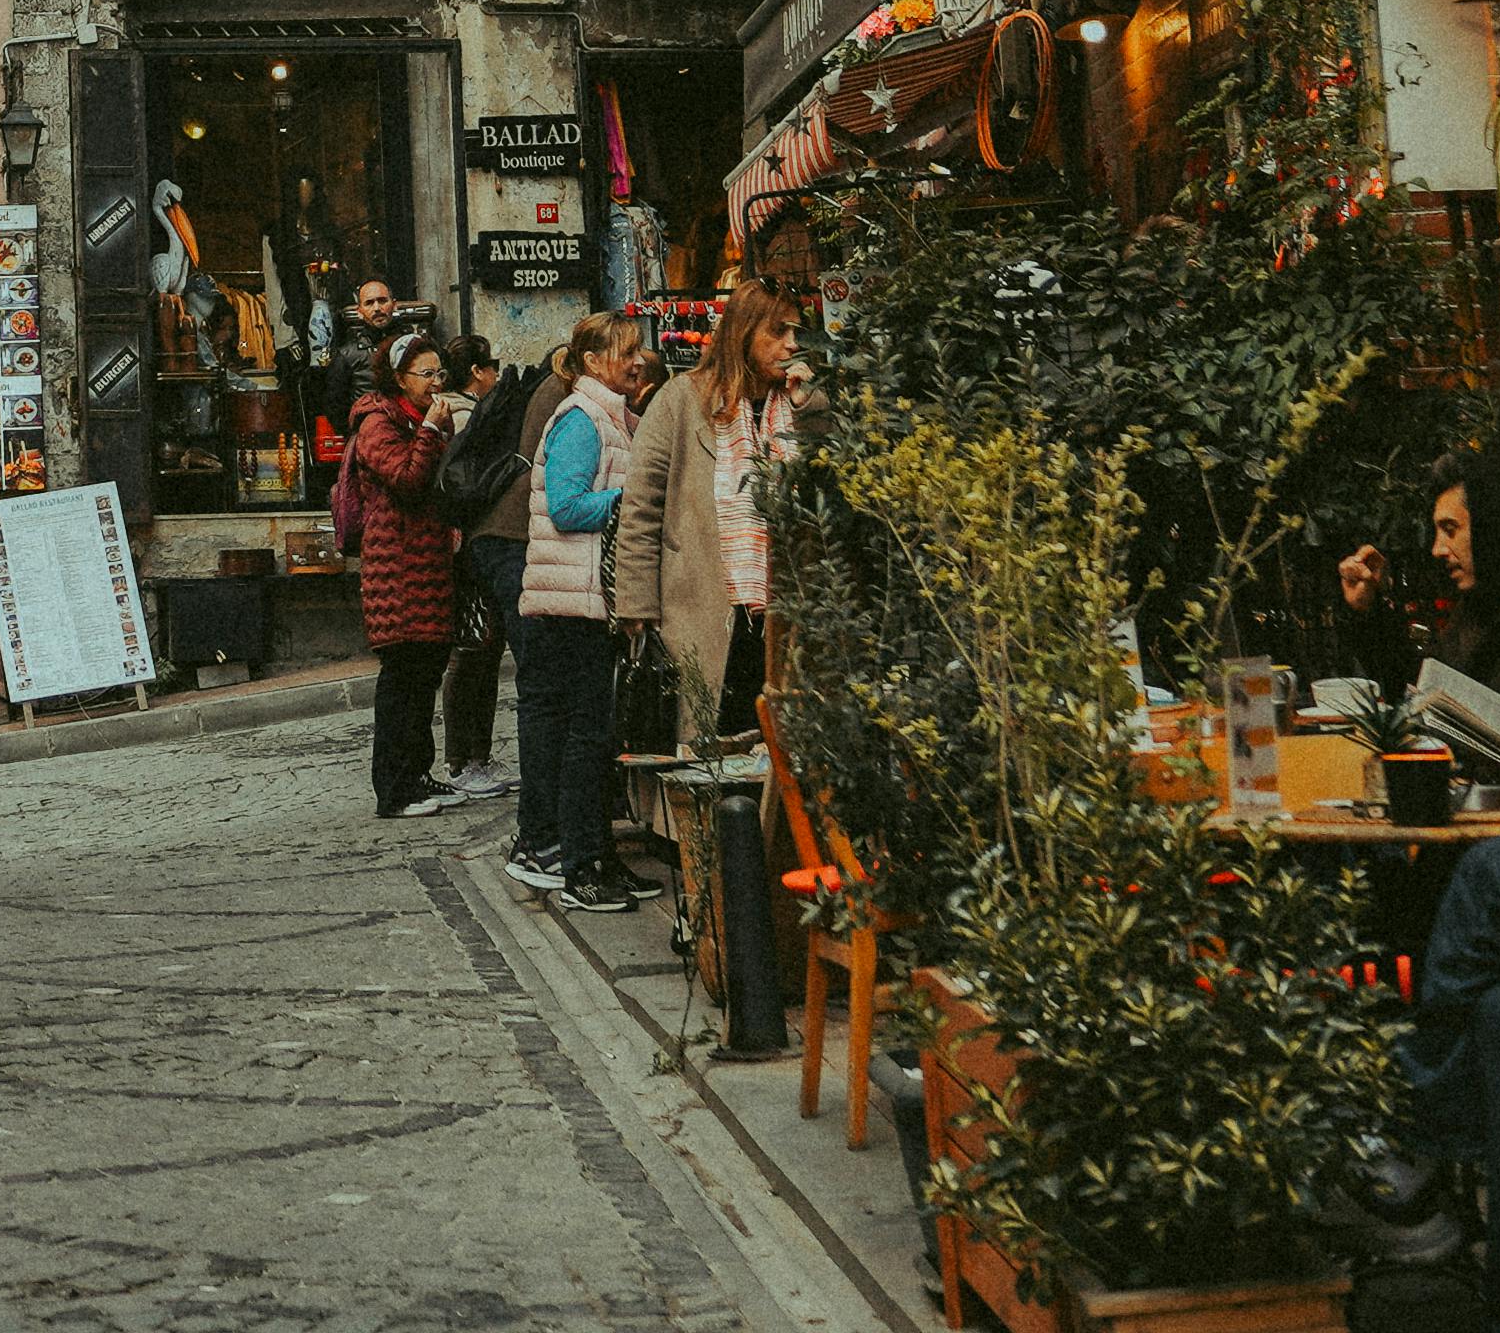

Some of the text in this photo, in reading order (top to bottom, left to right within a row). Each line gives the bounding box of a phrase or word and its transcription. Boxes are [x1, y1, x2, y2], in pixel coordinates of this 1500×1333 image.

[481, 123, 582, 147] BALLAD
[500, 151, 565, 170] boutique
[88, 201, 132, 242] BREAKFAST
[490, 239, 580, 262] ANTIQUE
[513, 270, 560, 287] SHOP
[94, 352, 134, 392] BURGER
